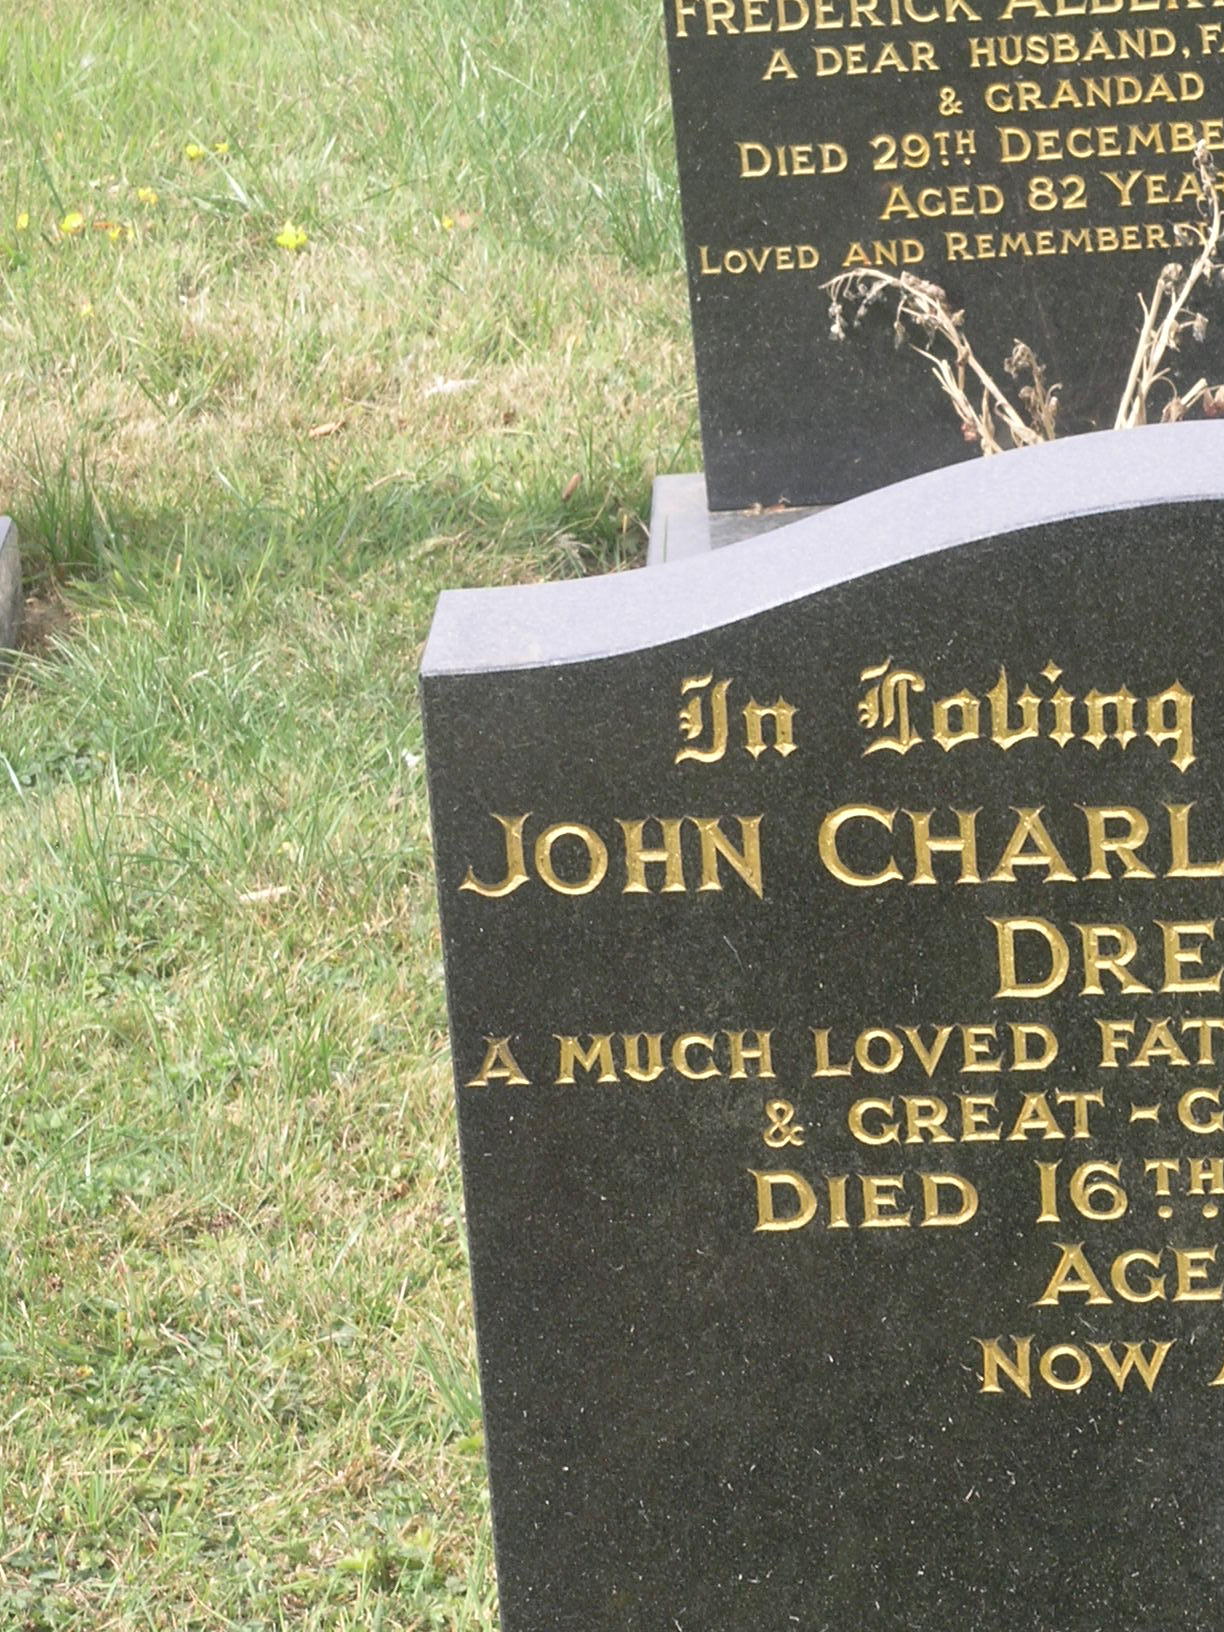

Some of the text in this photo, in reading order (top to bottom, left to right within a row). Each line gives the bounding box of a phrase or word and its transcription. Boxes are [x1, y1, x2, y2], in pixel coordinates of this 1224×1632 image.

[673, 0, 984, 39] FREDERICK
[760, 47, 799, 82] A
[813, 39, 941, 78] DEAR
[967, 26, 1192, 69] HUSBAND,
[937, 70, 1206, 118] & GRANDAD
[735, 140, 850, 179] DIED
[878, 181, 1006, 222] AGED
[1026, 172, 1089, 213] 82
[698, 243, 821, 276] LOVED
[840, 237, 926, 272] AND
[673, 671, 799, 766] In
[856, 657, 1198, 775] Loving
[457, 811, 765, 901] JOHN
[464, 1037, 530, 1088] A
[553, 1030, 778, 1086] MUCH
[810, 1022, 1060, 1079] LOVED
[762, 1097, 807, 1150] &
[746, 1166, 980, 1234] DIED
[976, 1335, 1176, 1400] NOW
